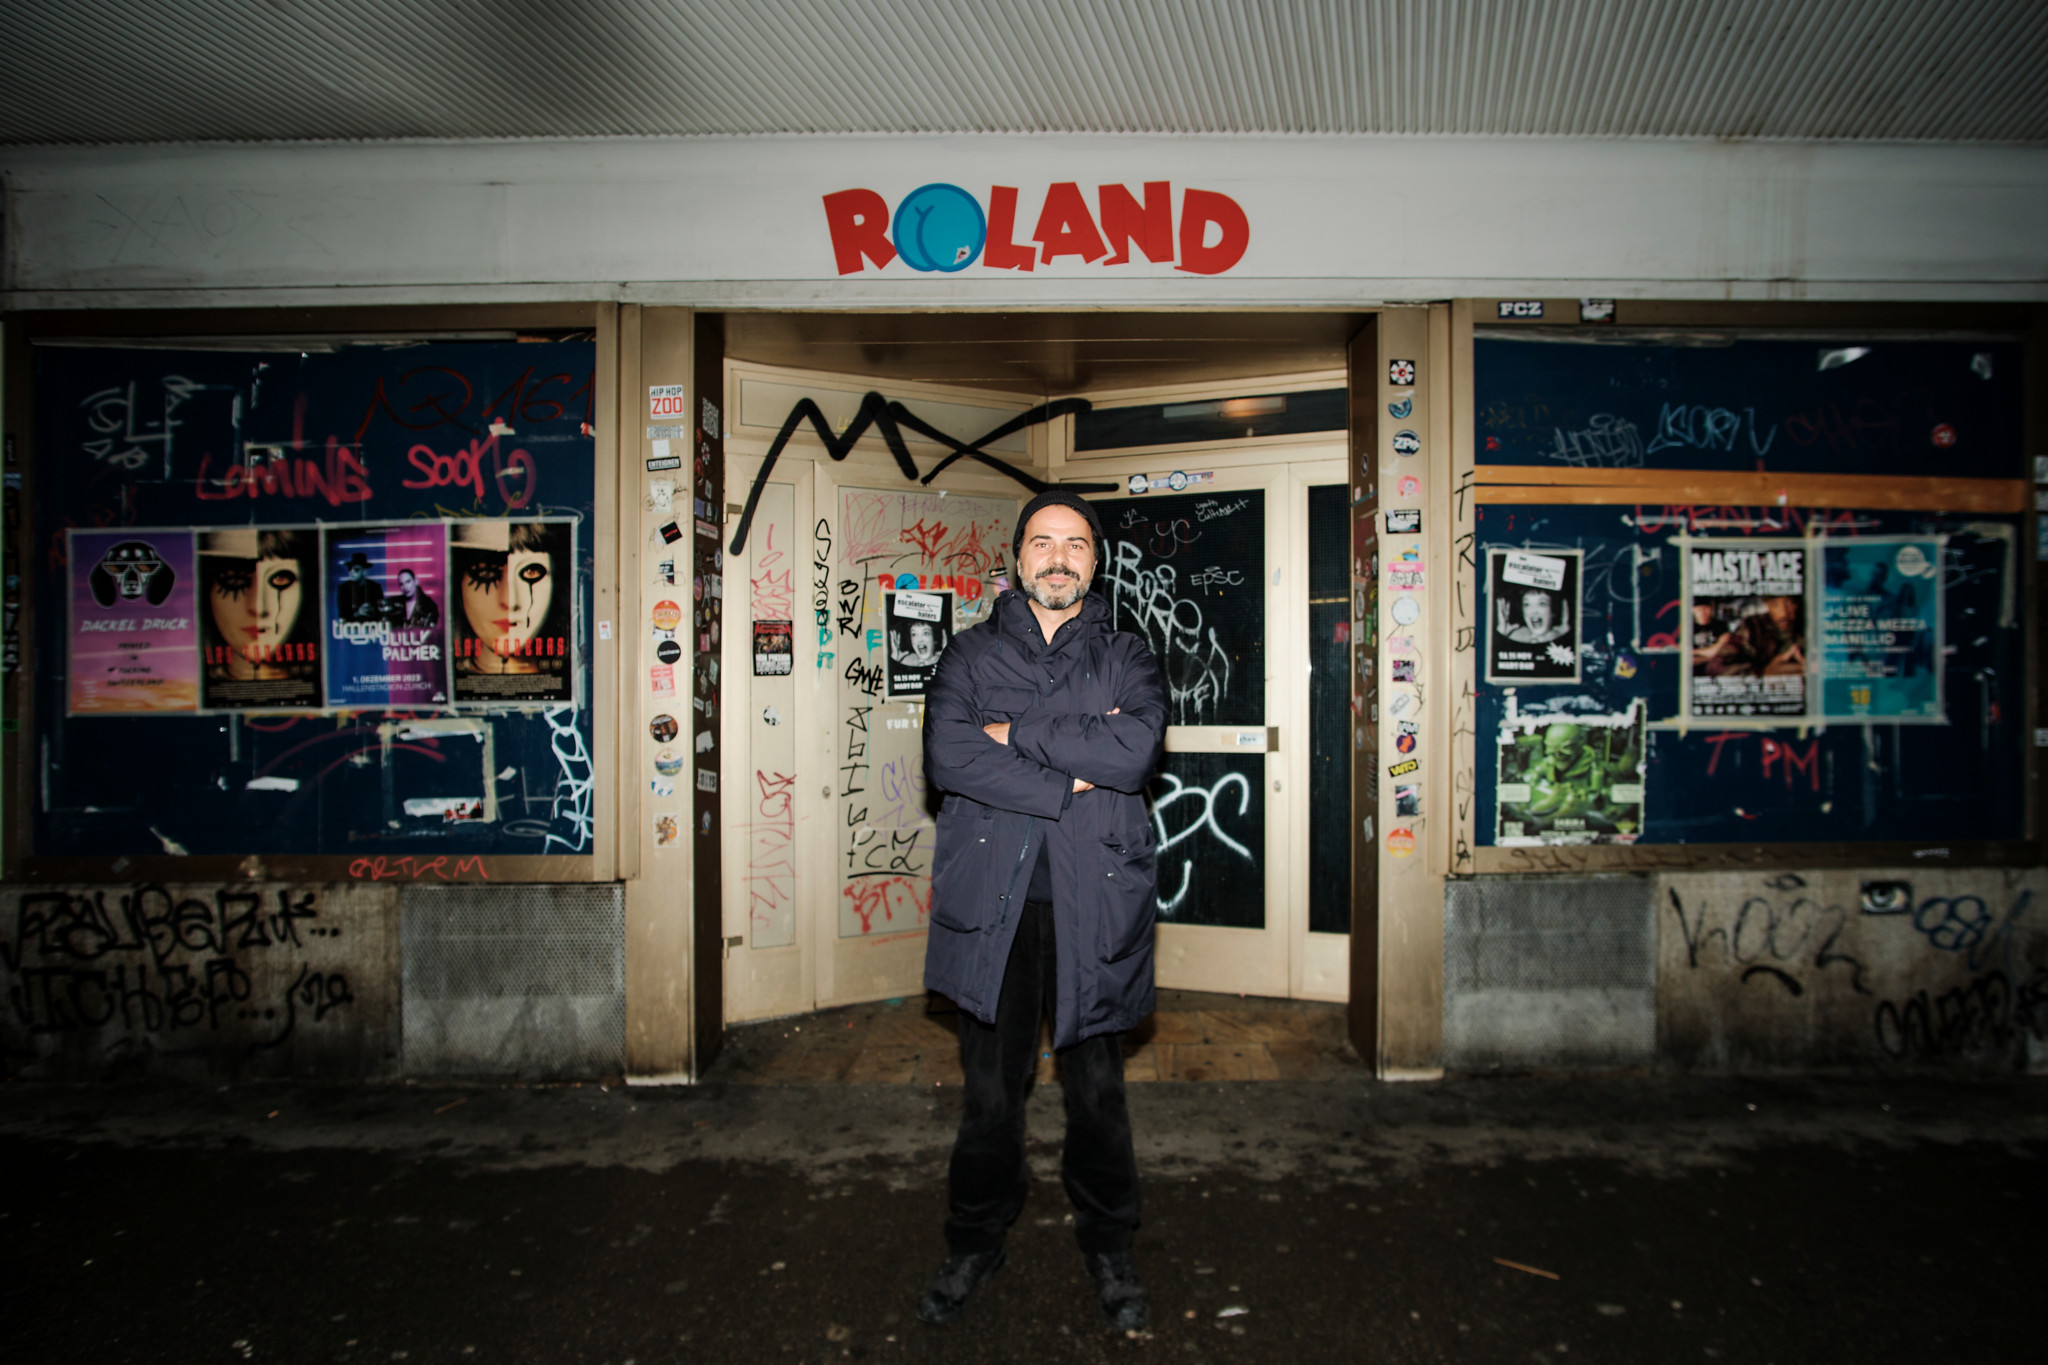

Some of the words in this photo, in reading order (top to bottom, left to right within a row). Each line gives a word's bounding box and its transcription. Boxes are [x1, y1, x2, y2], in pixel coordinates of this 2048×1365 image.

[822, 180, 1250, 276] ROLAND
[1499, 302, 1543, 317] FCZ
[650, 387, 664, 397] HIP
[666, 386, 682, 396] HOP
[652, 396, 684, 415] ZOO
[1692, 551, 1763, 582] MASTA
[1764, 550, 1804, 580] ACE
[897, 599, 927, 609] escalator
[80, 618, 138, 632] DACKEL
[142, 617, 190, 632] DRUCK
[382, 645, 442, 662] PALMER
[454, 637, 482, 658] LAS
